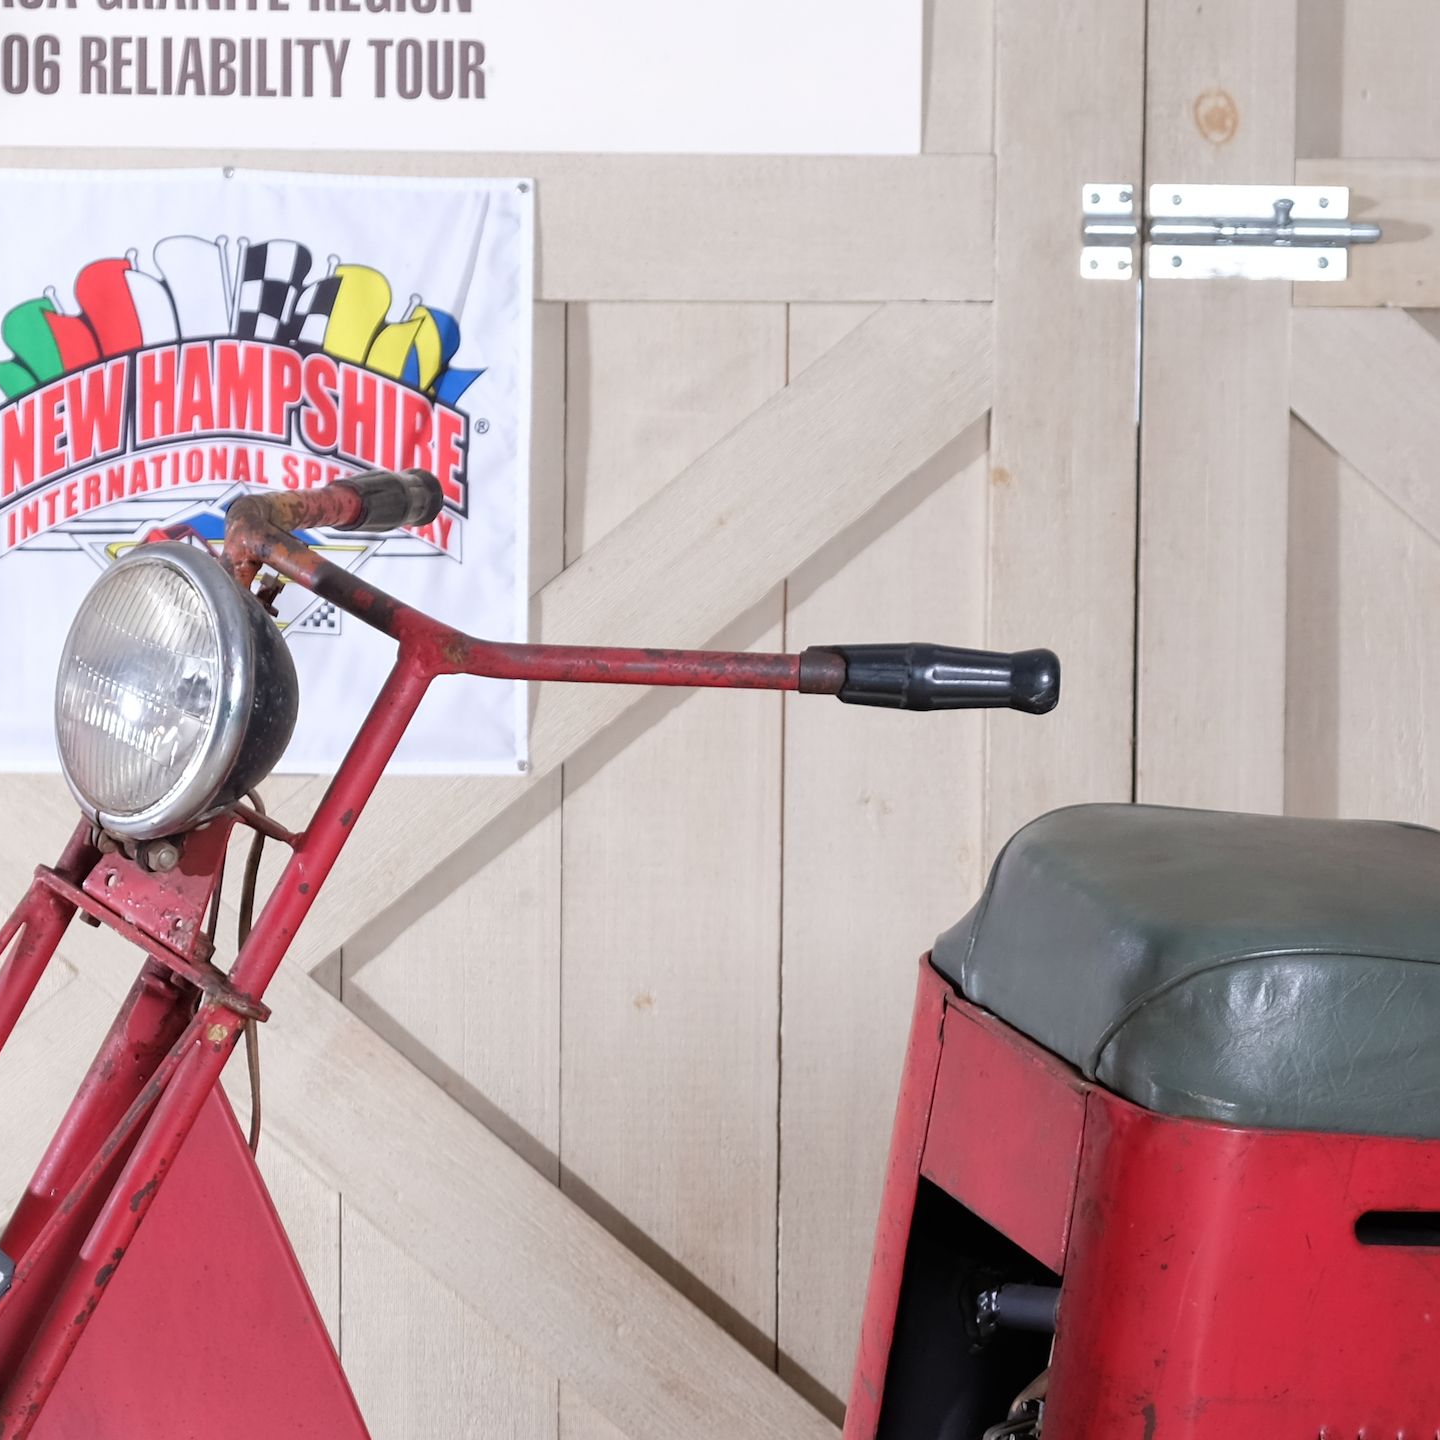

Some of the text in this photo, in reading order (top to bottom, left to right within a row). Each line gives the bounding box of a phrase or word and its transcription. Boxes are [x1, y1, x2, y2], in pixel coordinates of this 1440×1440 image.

[79, 36, 351, 99] RELIABILITY
[367, 39, 486, 101] TOUR
[0, 341, 465, 506] NEW HAMPSHIRE
[7, 446, 269, 550] INTERNATIONAL
